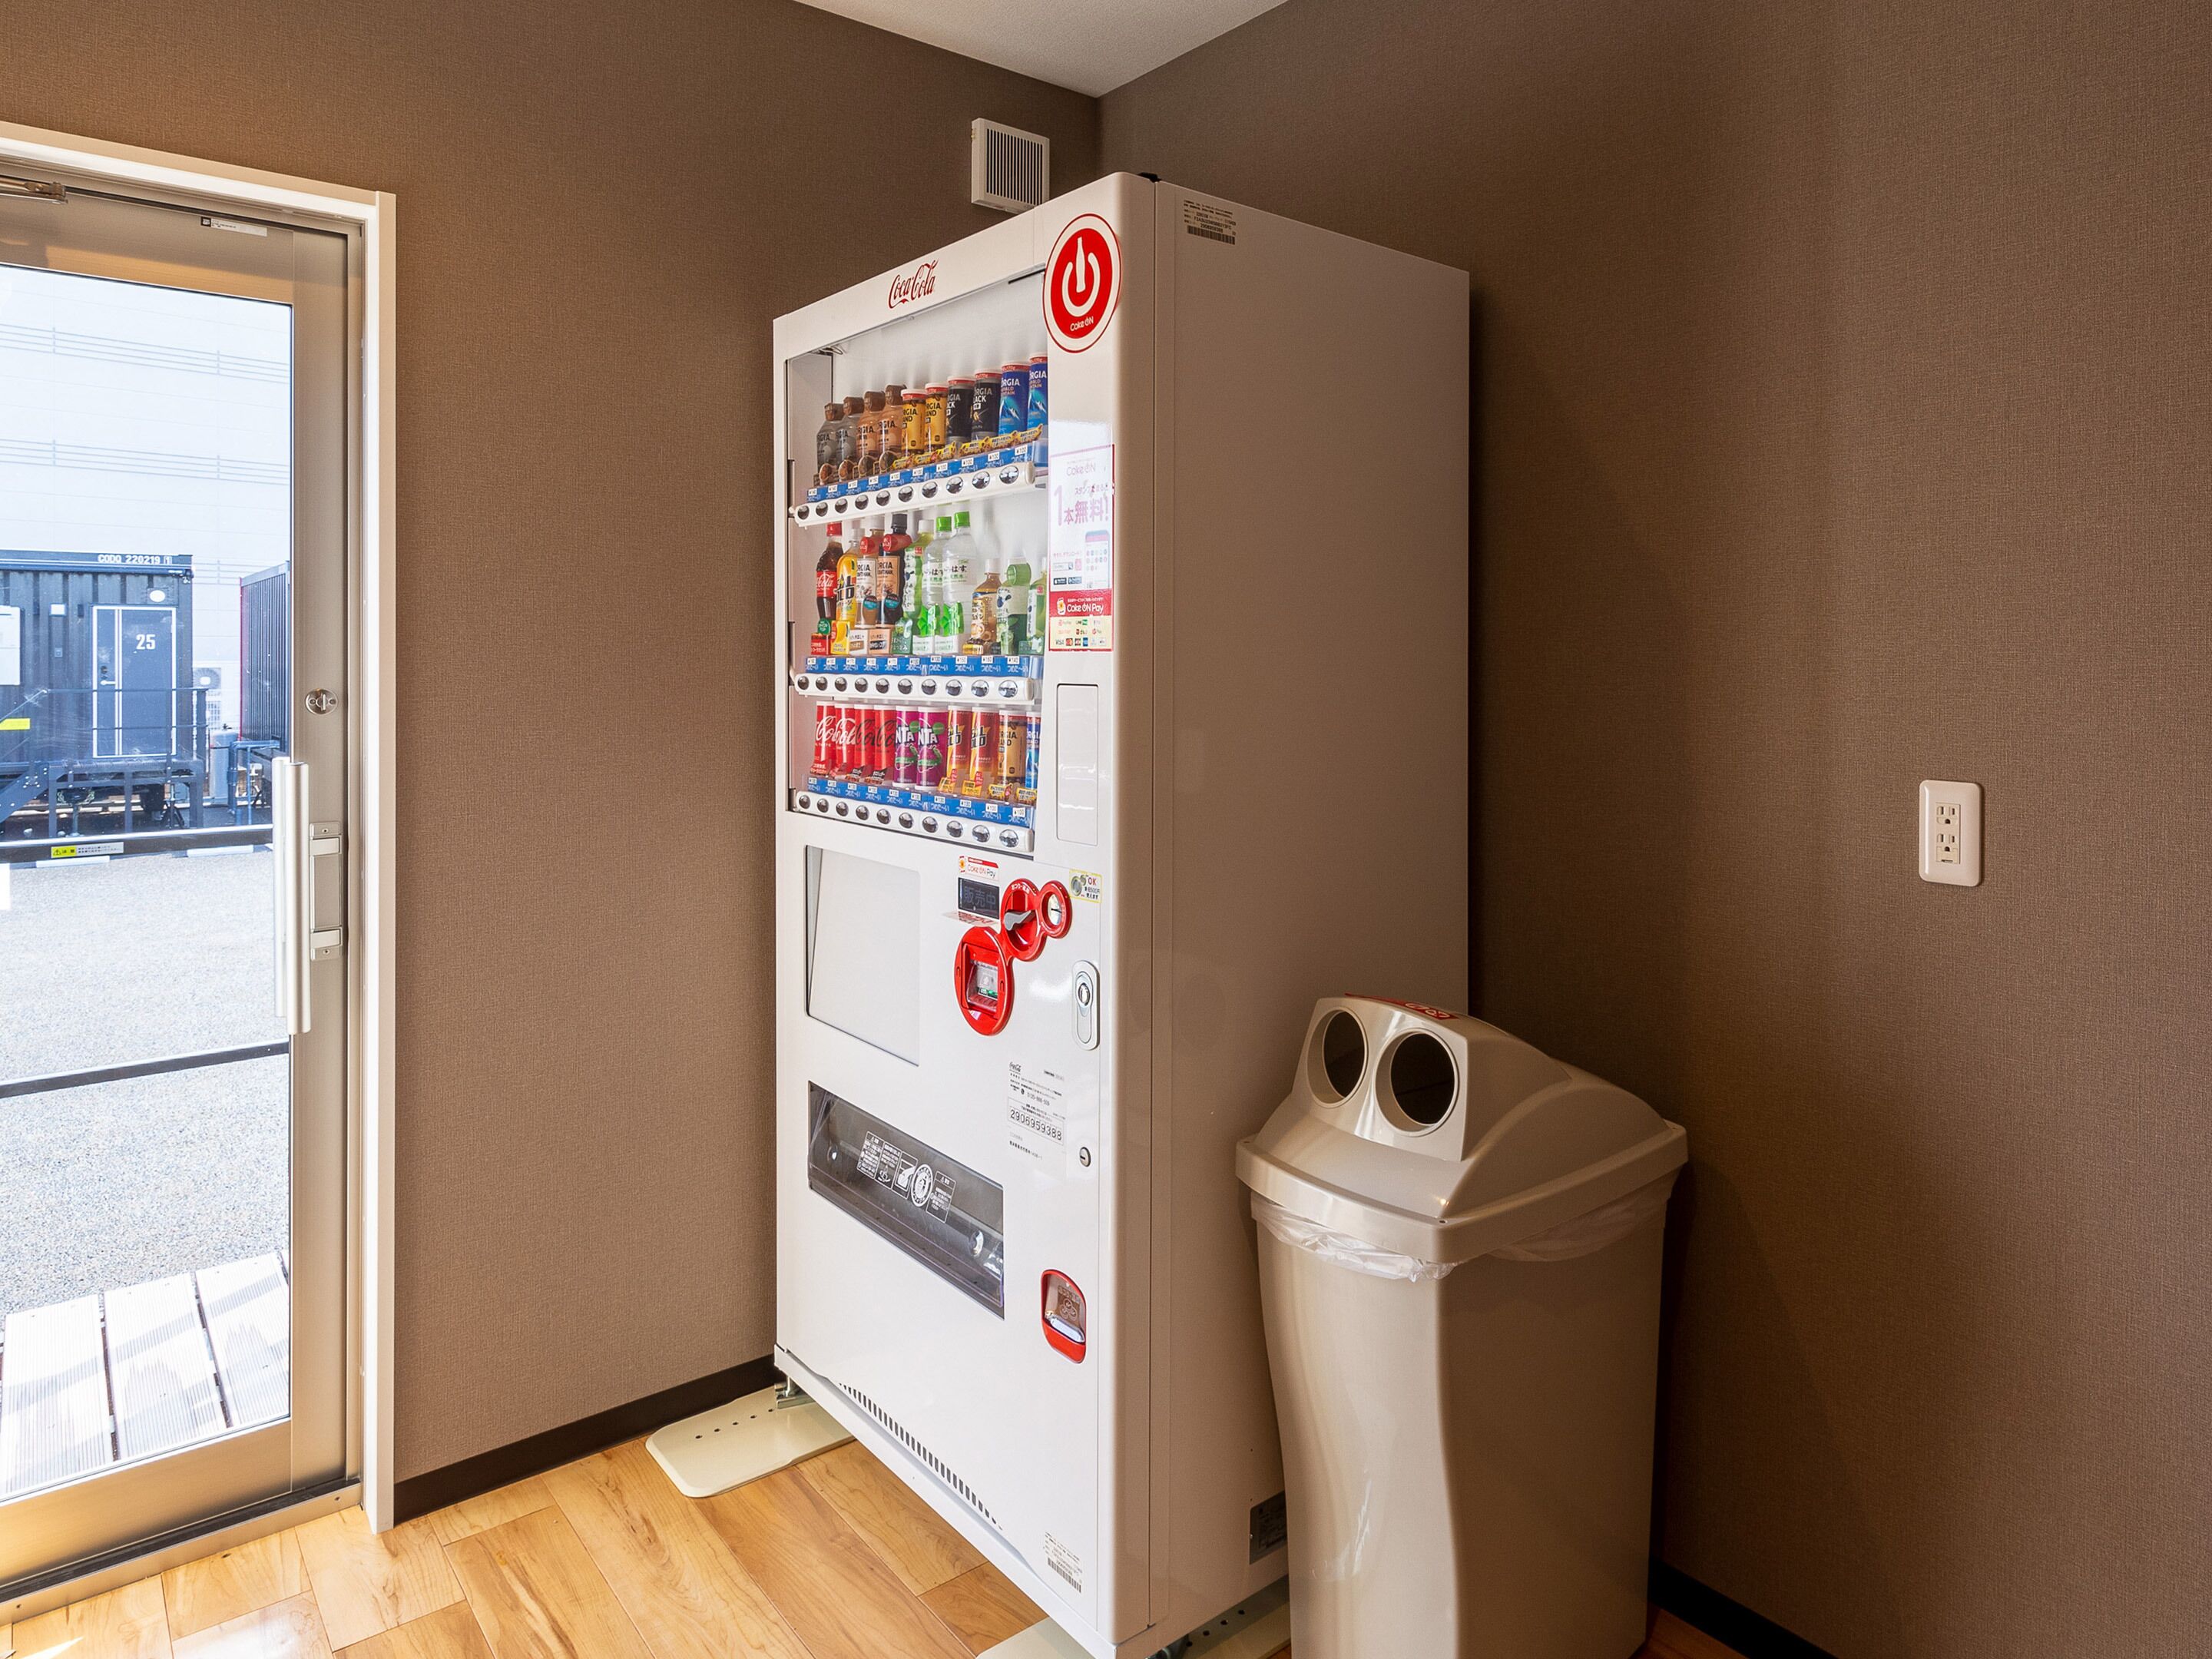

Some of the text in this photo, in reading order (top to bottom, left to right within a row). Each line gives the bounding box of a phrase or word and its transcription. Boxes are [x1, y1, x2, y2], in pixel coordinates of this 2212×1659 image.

[889, 259, 939, 308] Coca-Cola
[125, 555, 161, 565] 220219
[1067, 602, 1104, 614] Coke ON Pay
[136, 634, 156, 650] 25
[986, 868, 996, 879] Pay
[1088, 876, 1097, 886] OK
[963, 885, 997, 909] 販売中
